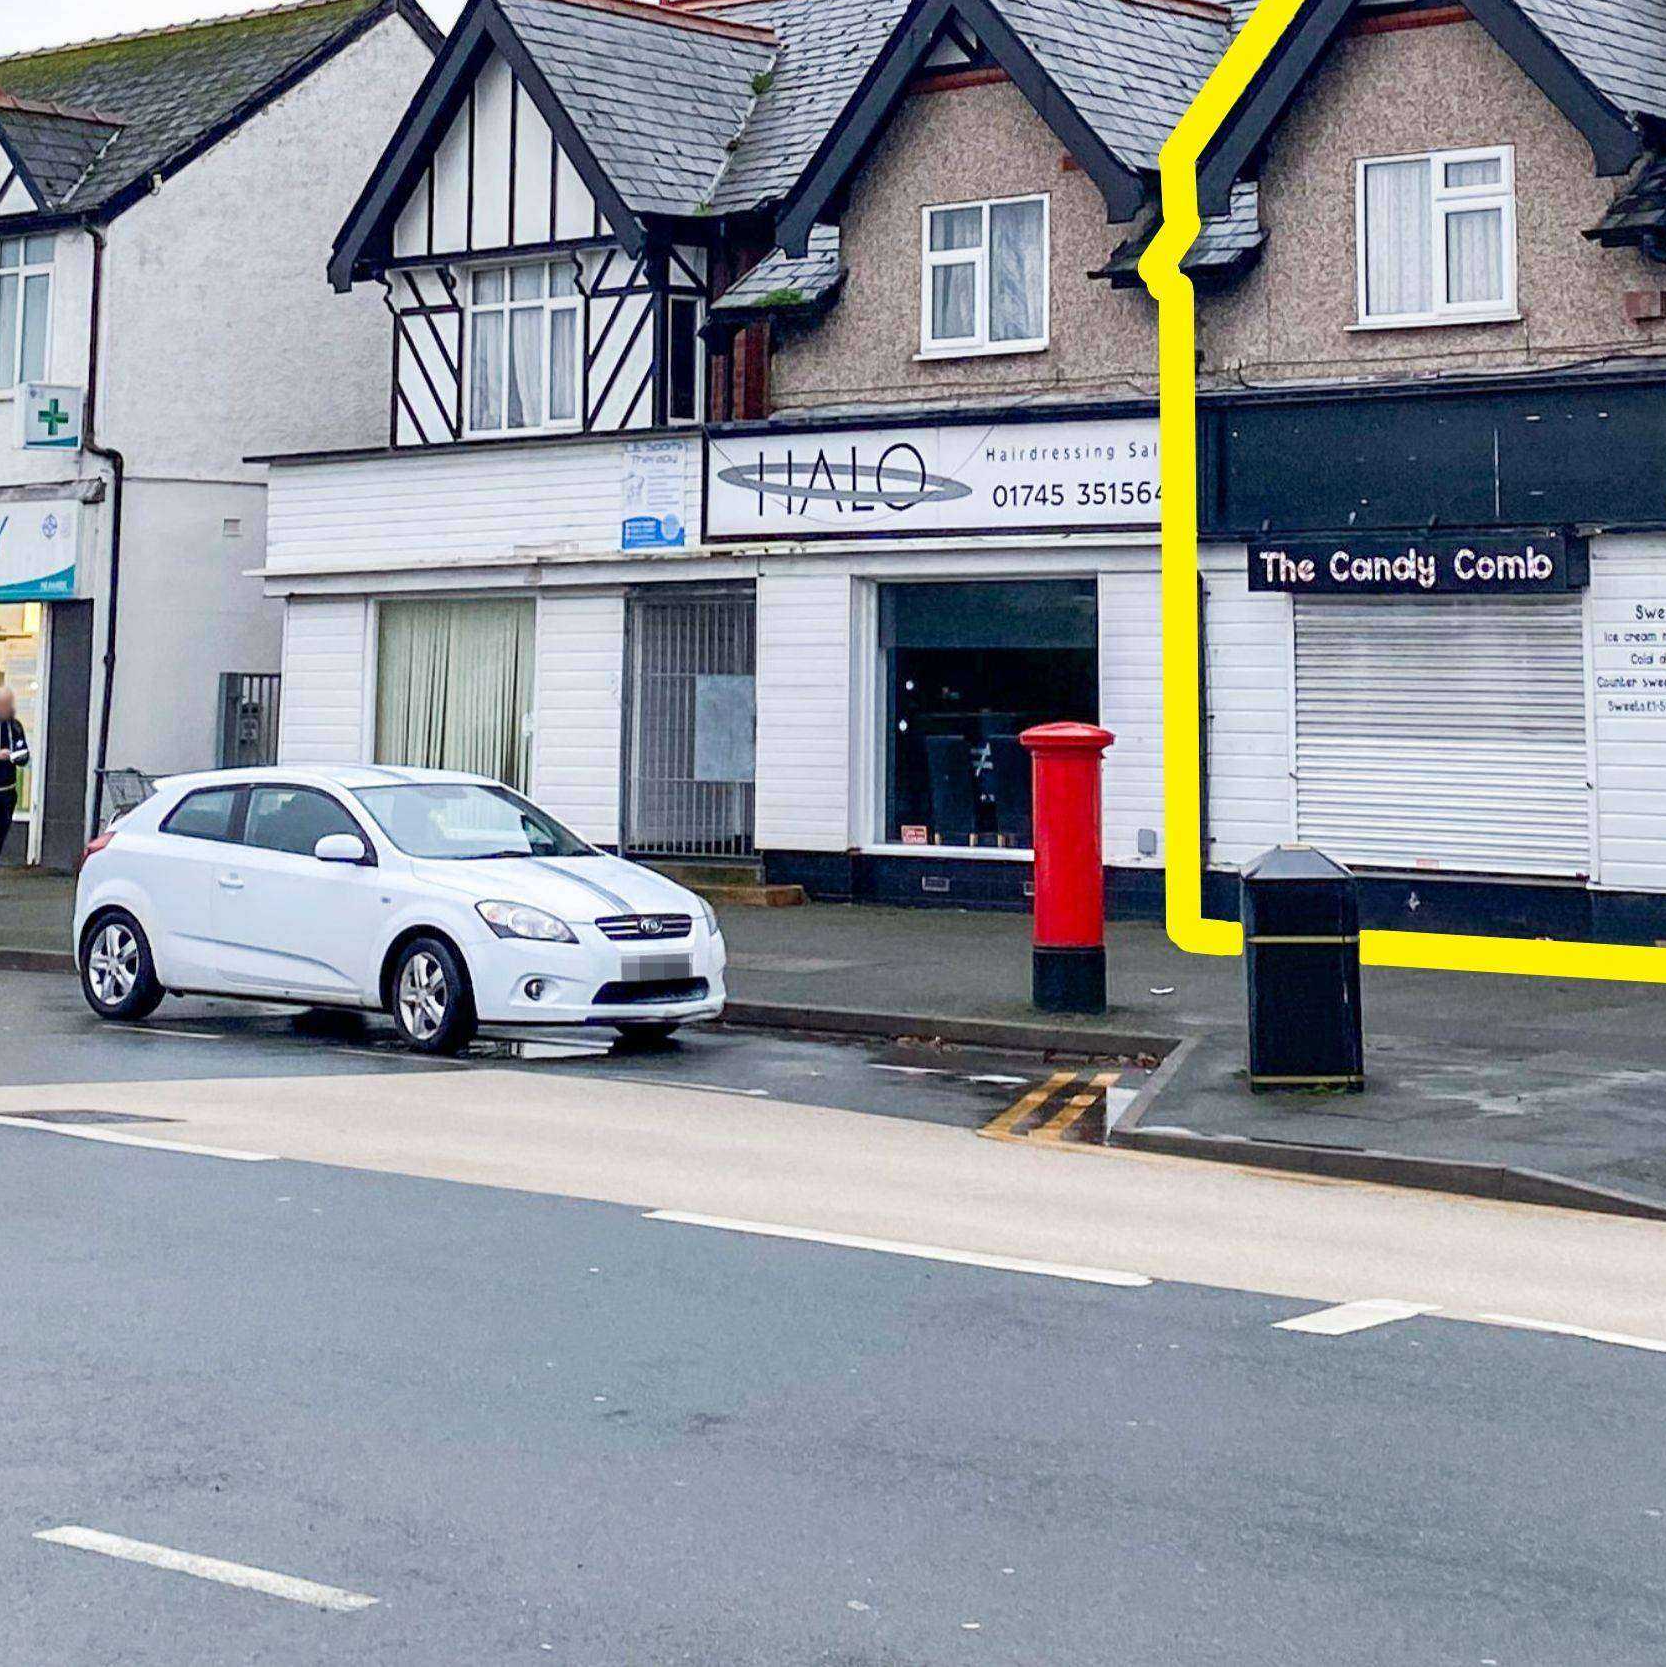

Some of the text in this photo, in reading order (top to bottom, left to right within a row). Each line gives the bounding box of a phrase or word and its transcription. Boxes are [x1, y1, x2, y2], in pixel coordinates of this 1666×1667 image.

[986, 441, 1158, 462] Hairdressing Sal
[759, 443, 926, 515] HALO
[993, 484, 1064, 508] 01745
[1259, 546, 1552, 588] The Candy Comb
[1604, 632, 1618, 642] Ice
[1624, 632, 1657, 642] cream
